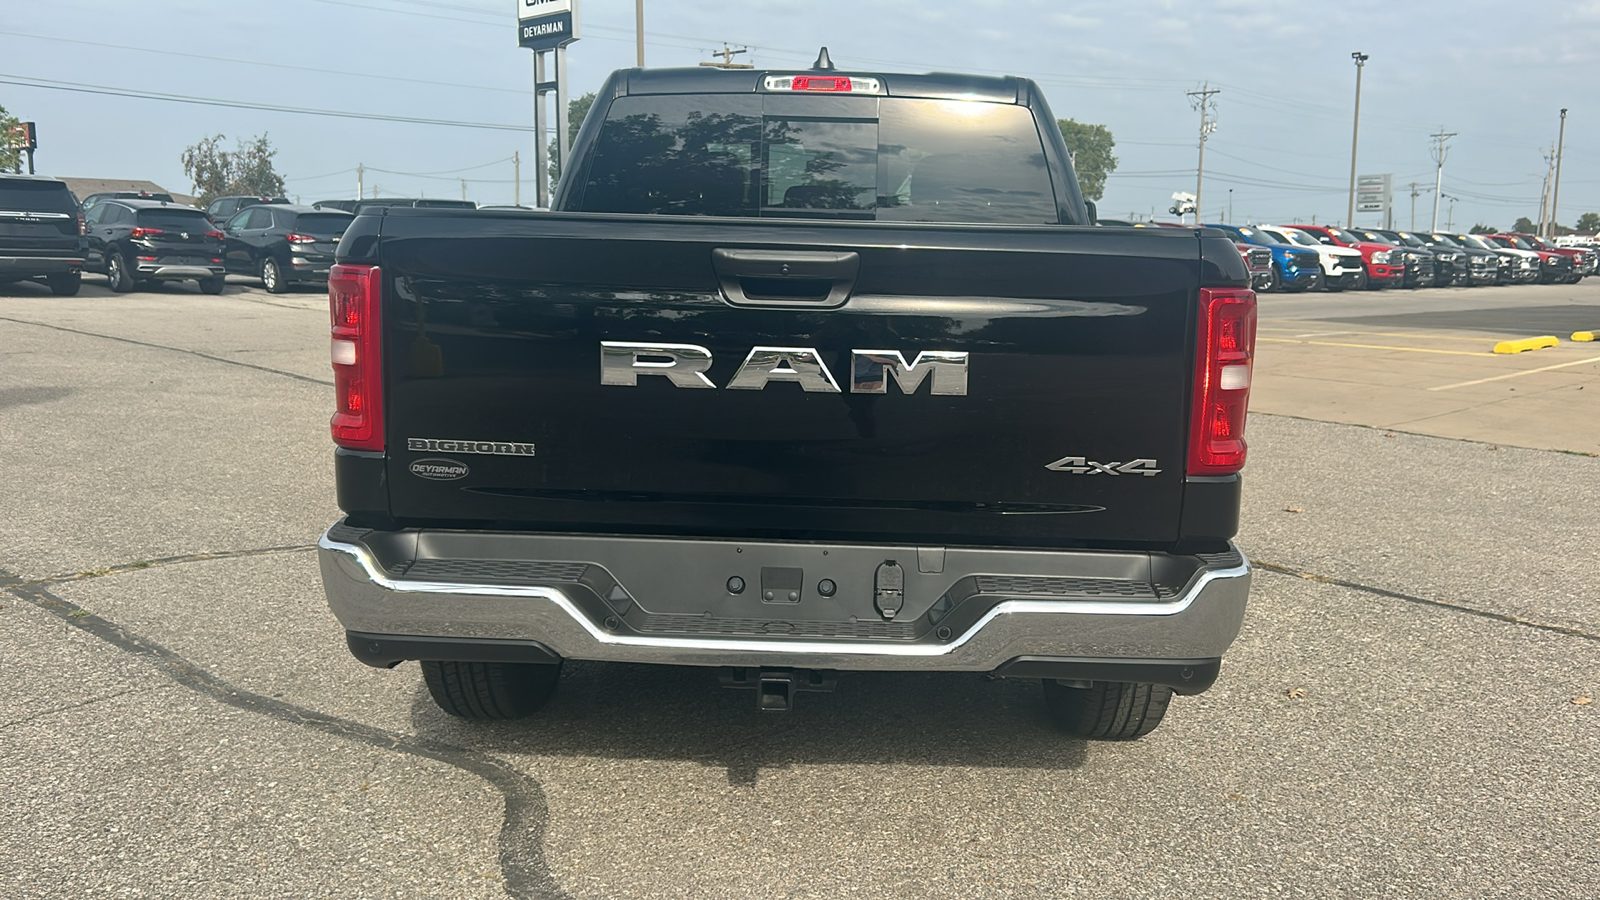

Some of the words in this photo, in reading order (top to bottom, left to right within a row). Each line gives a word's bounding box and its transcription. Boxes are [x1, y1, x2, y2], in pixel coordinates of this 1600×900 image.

[523, 21, 563, 38] DEYARMAN
[600, 341, 969, 396] RAM
[408, 438, 535, 456] BIGHORN
[412, 464, 467, 474] DEYARMAN
[1044, 456, 1163, 476] 4x4
